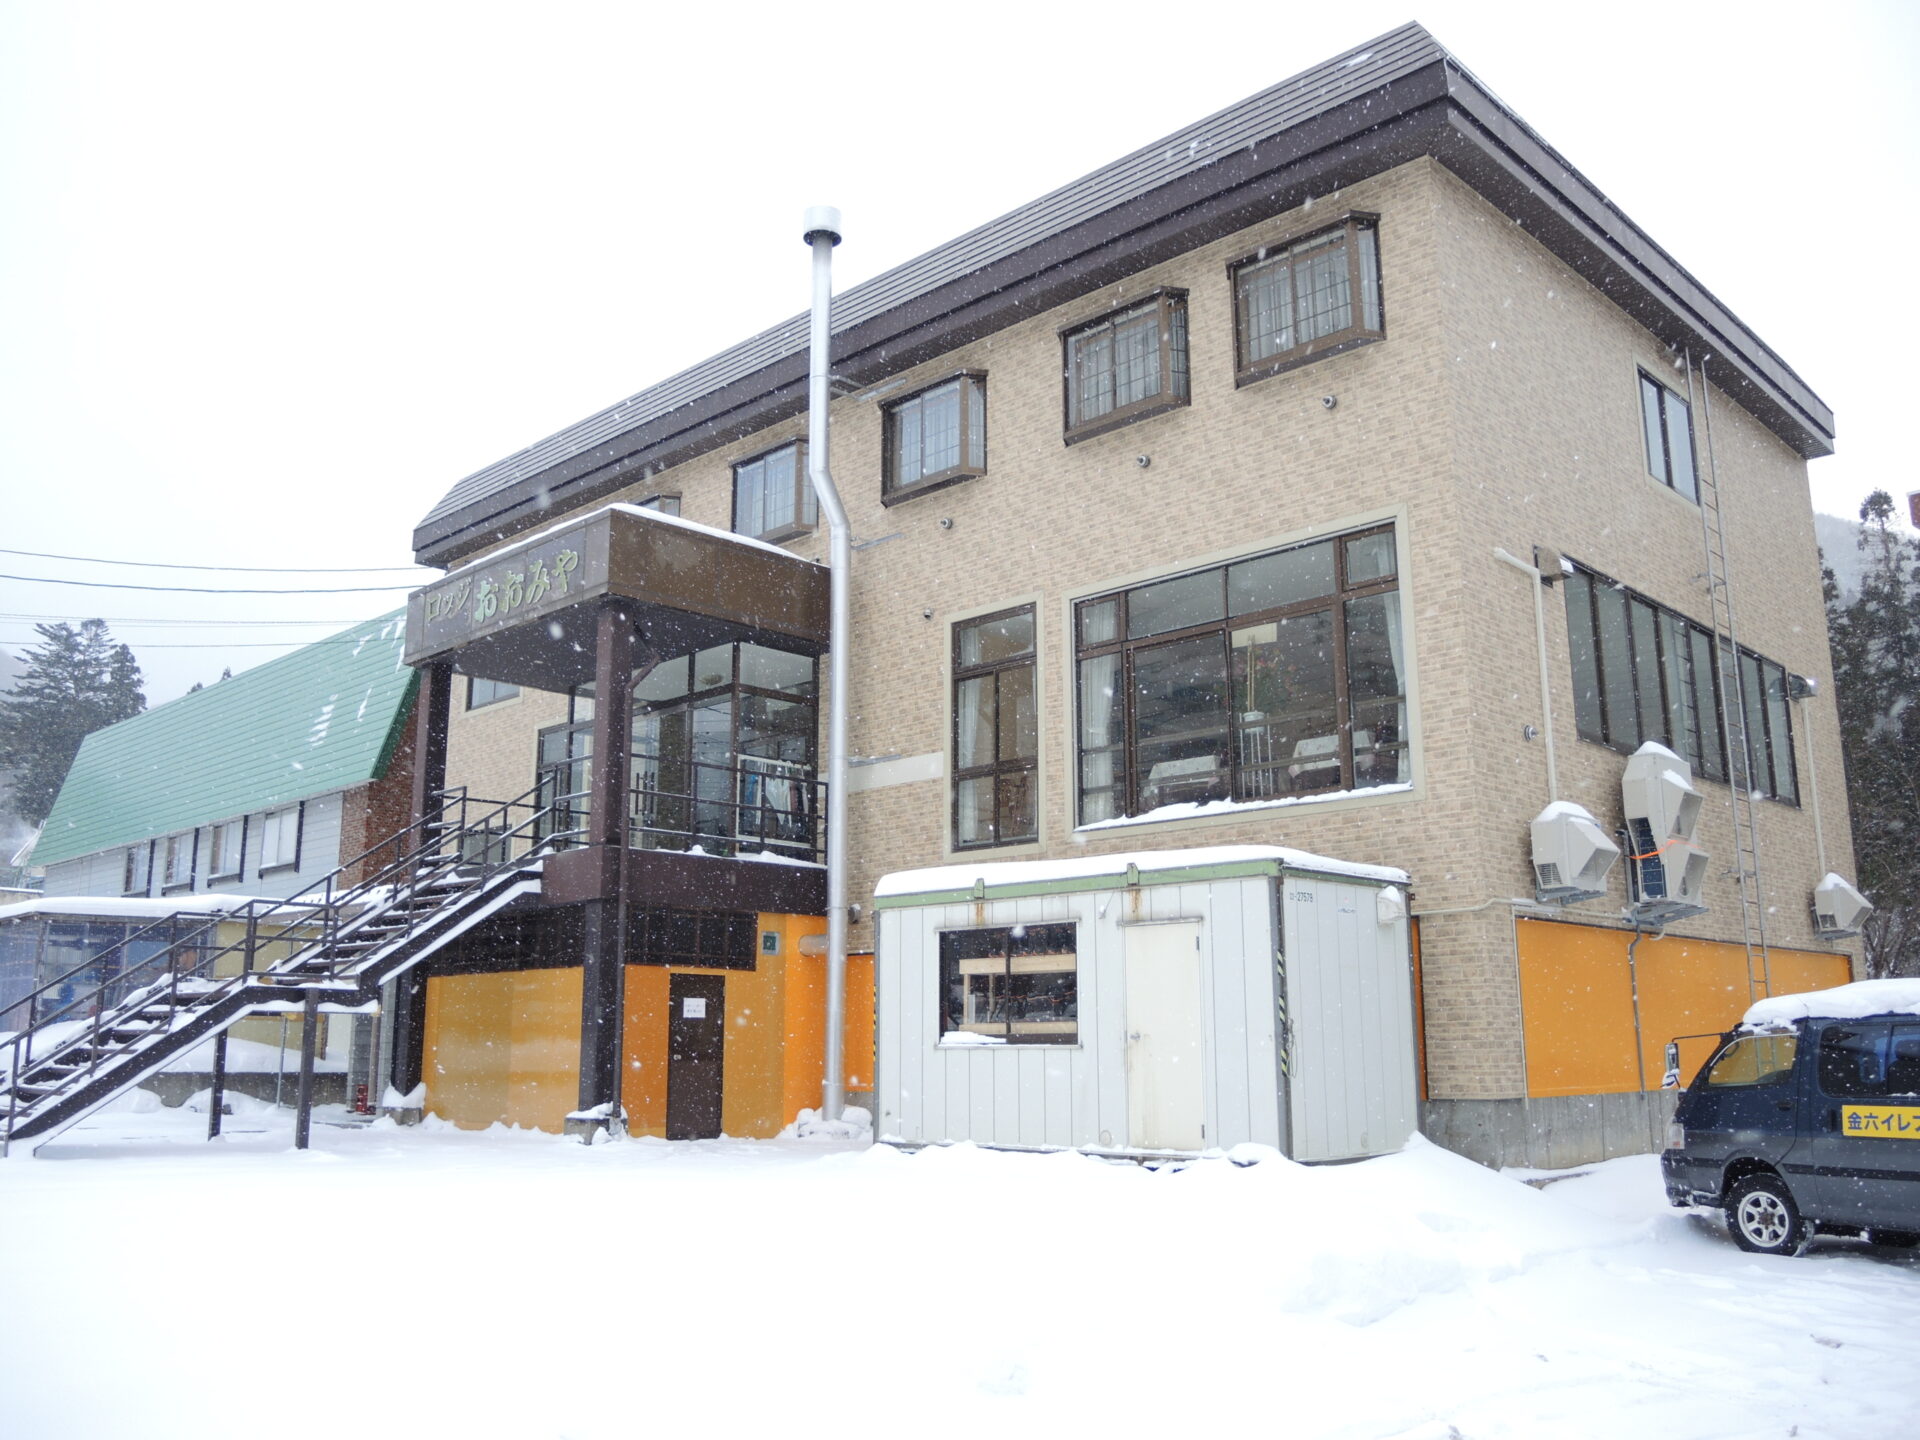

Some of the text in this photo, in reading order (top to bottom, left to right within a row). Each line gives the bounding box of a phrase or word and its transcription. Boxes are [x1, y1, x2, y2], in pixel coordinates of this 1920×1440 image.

[425, 549, 579, 623] ロッジ おおみや
